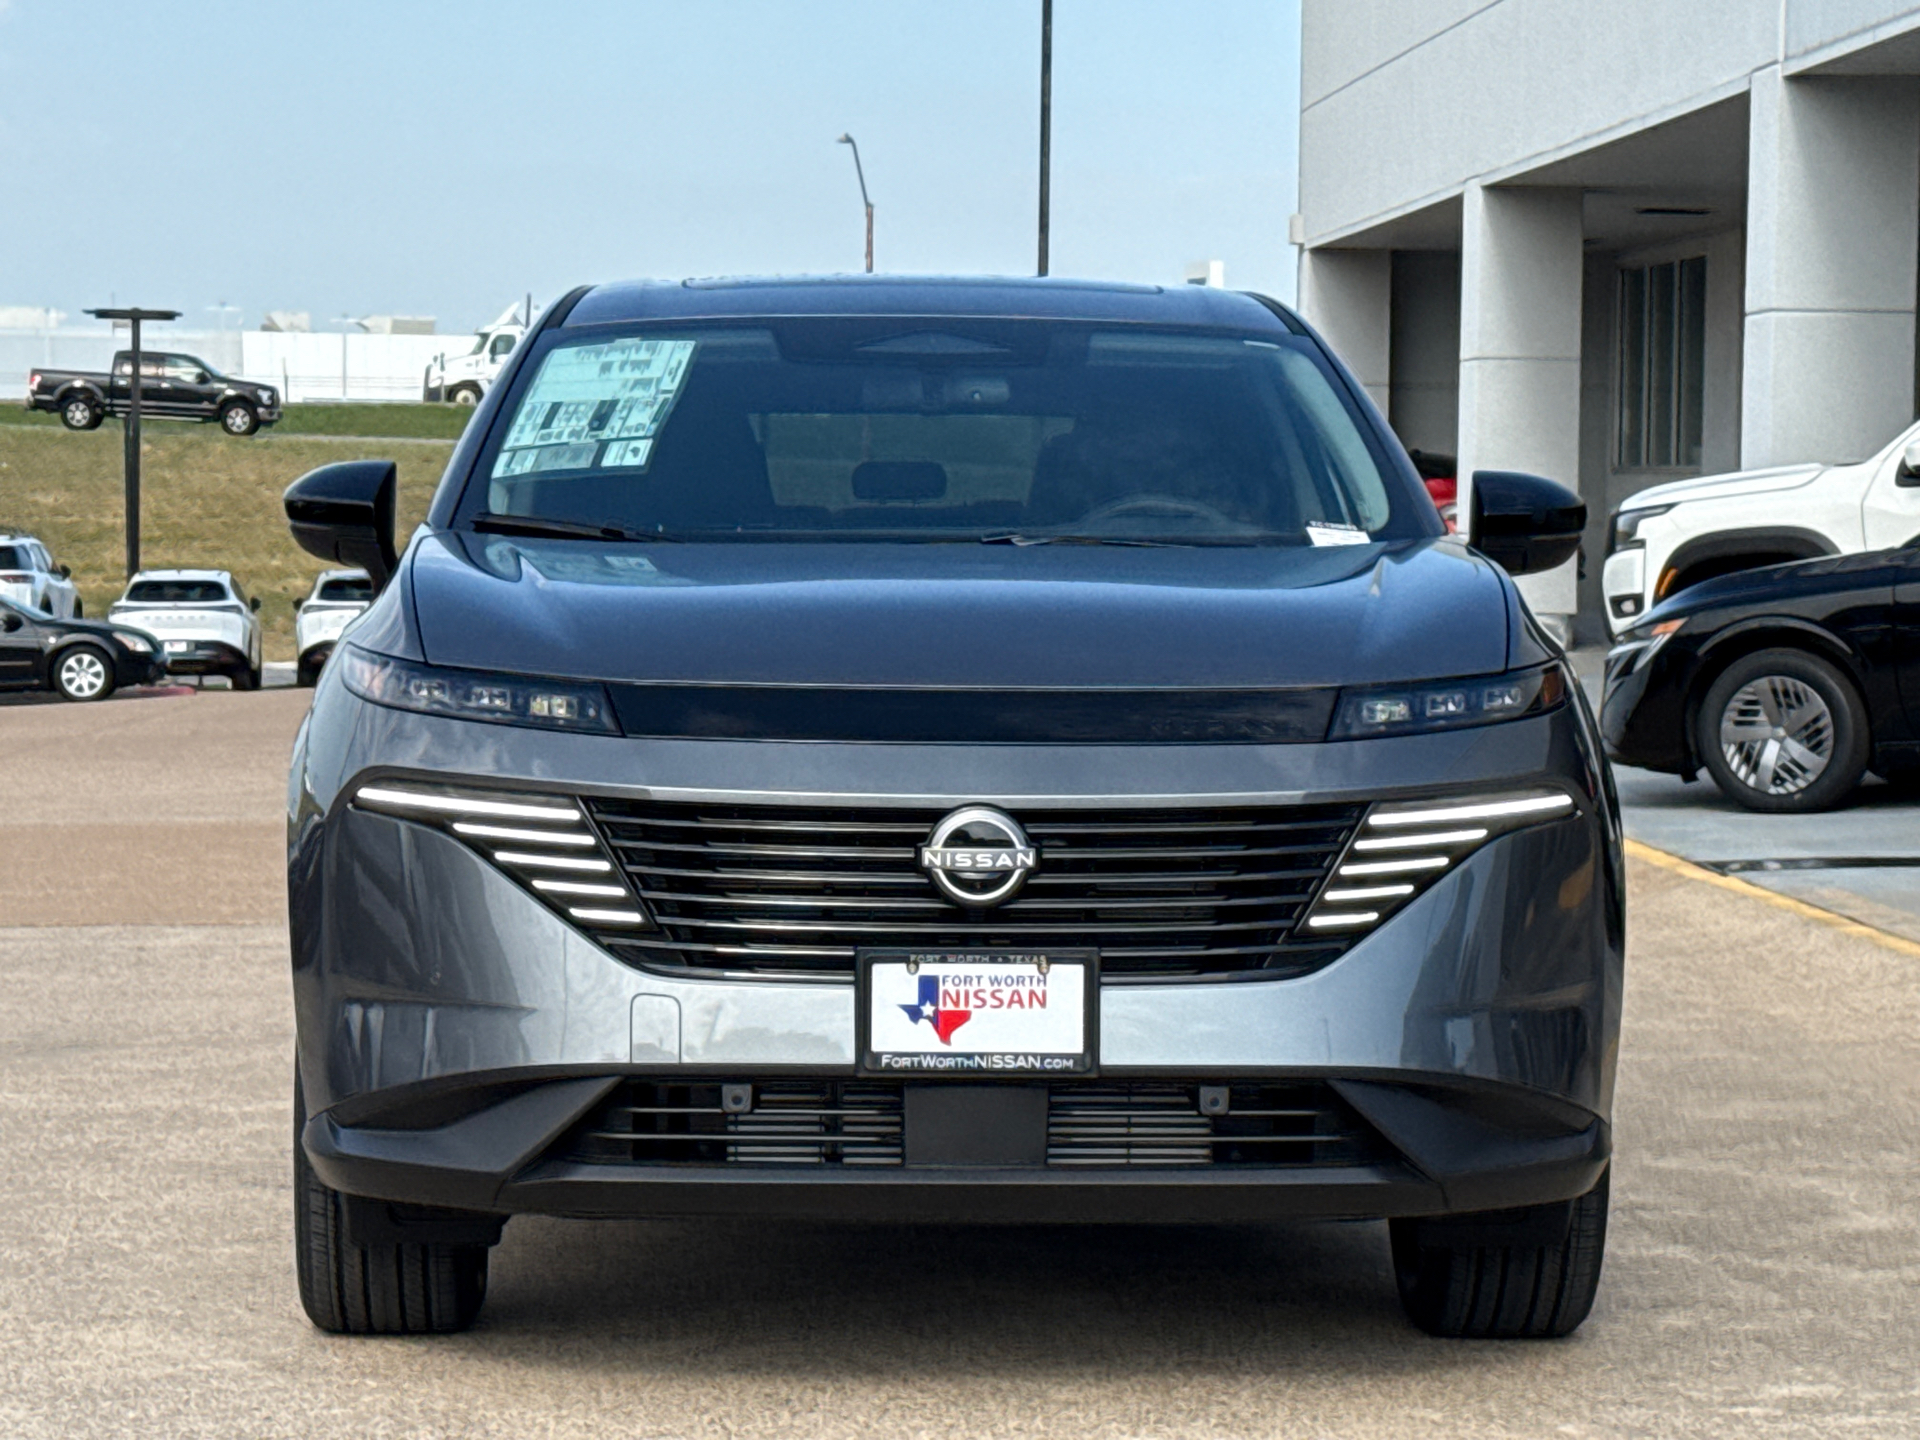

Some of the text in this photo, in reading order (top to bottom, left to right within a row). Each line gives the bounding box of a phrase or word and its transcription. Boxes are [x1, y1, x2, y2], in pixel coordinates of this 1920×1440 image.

[924, 851, 1034, 868] NISSAN
[909, 954, 1047, 965] FORT WORTH TEXAS
[942, 974, 1047, 988] FORT WORTH
[942, 988, 1047, 1009] NISSAN
[881, 1054, 1074, 1069] FORTWORTHNISSAN.COM
